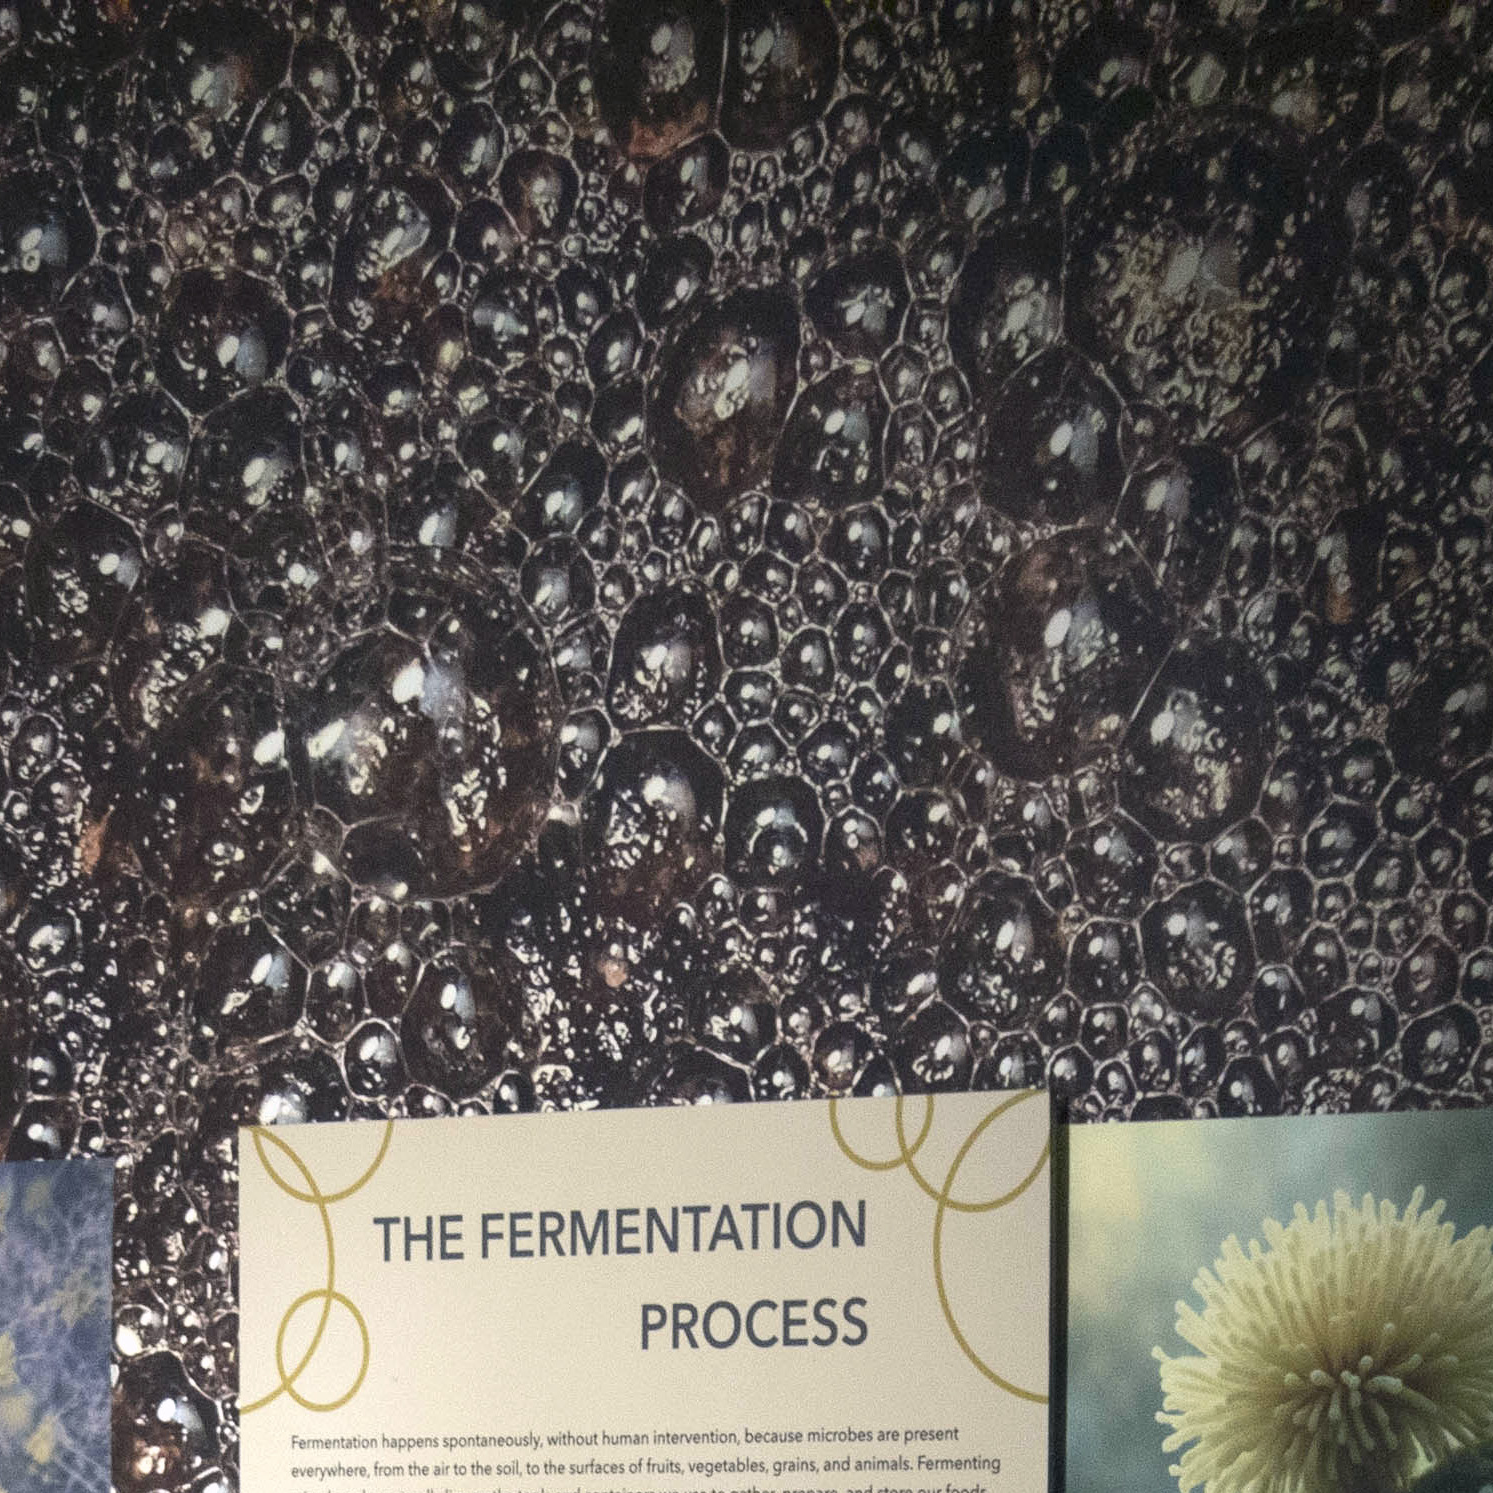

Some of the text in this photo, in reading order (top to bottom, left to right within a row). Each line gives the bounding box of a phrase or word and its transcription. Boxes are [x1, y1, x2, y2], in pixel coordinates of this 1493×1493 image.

[373, 1199, 867, 1262] THE FERMENTATION
[640, 1297, 869, 1350] PROCESS
[291, 1426, 959, 1452] Fermentation happens spontaneously, without human intervention, because microbes are present
[291, 1453, 1001, 1481] everywhere, from the air to the soil, to the surfaces of fruits, vegetables, grains, and animals. Fermenting
